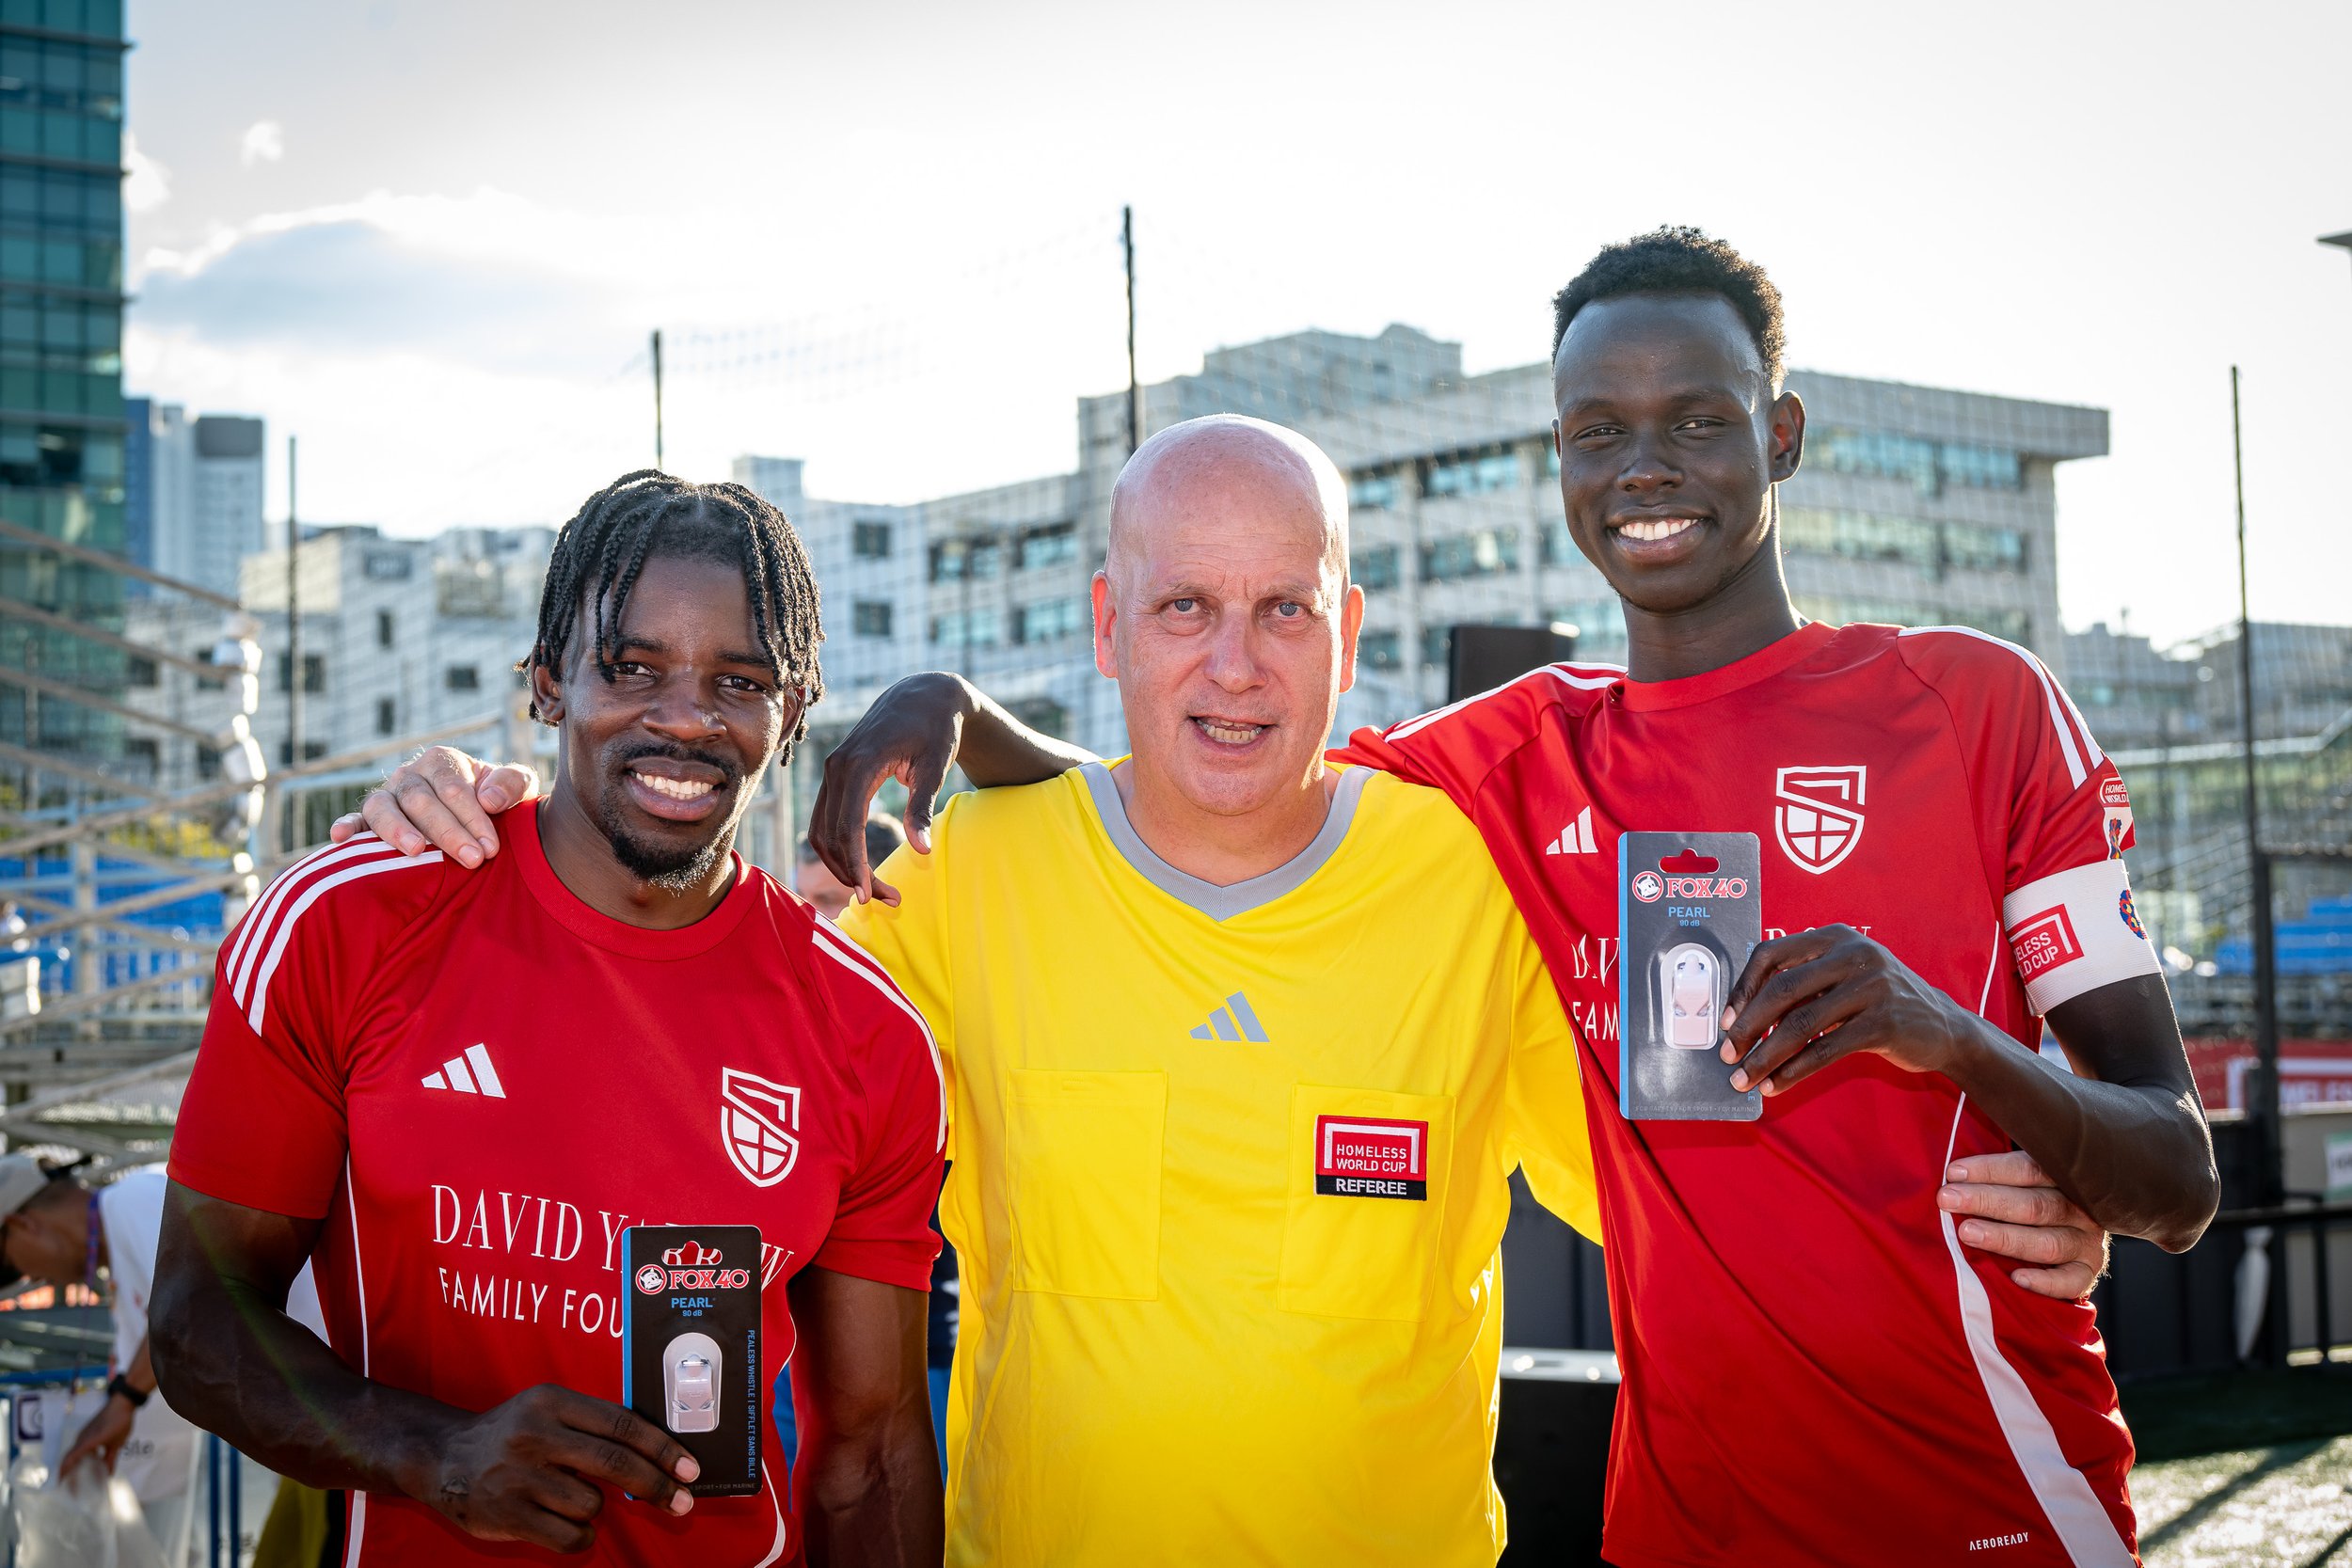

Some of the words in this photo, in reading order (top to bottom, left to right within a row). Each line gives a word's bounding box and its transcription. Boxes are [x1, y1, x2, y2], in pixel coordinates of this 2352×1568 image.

[1668, 906, 1710, 918] PEARL
[2015, 931, 2052, 961] ELESS
[2031, 945, 2059, 969] CUP
[1336, 1144, 1407, 1160] HOMELESS
[1336, 1158, 1379, 1171] WORLD
[1382, 1162, 1406, 1173] CUP
[1336, 1178, 1407, 1196] REFEREE
[431, 1184, 583, 1262] DAVID
[438, 1267, 548, 1323] FAMILY
[671, 1297, 713, 1308] PEARL
[747, 1329, 755, 1364] PEALESS
[747, 1364, 755, 1398] WHISTLE
[747, 1404, 755, 1435] SIFFLET
[748, 1457, 756, 1479] BILLE
[1969, 1531, 2029, 1551] AEROREADY
